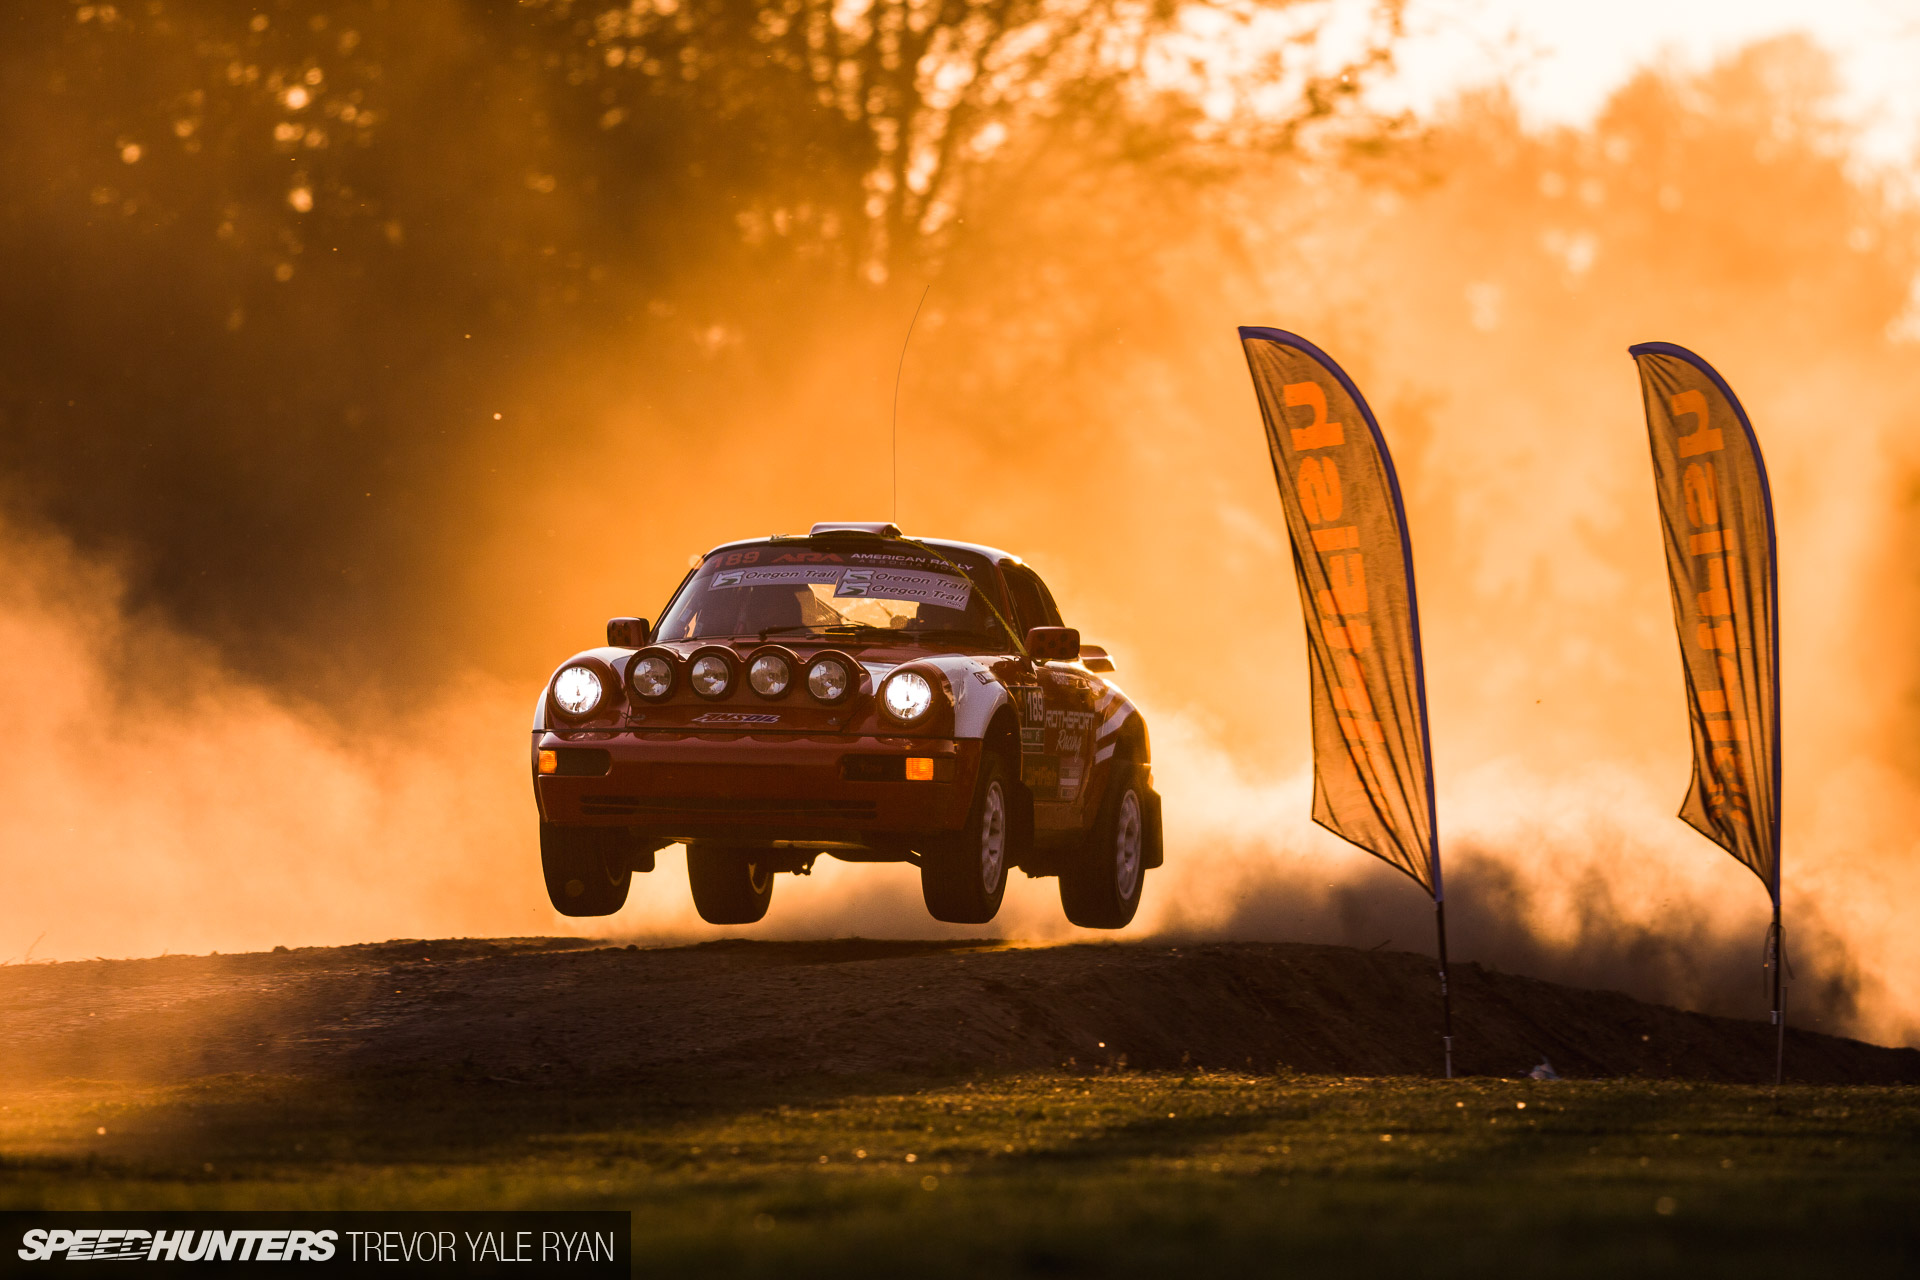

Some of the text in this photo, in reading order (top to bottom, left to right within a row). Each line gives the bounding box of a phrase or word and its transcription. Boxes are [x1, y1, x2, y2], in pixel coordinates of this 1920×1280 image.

[711, 551, 845, 568] 189 ARA
[850, 553, 926, 563] AMERICAN
[745, 570, 838, 580] Oregon Trail
[875, 573, 969, 592] Oregon Trail
[871, 585, 965, 603] Oregon Trail
[1027, 691, 1043, 721] 189
[1045, 710, 1095, 730] ROTHSPORT
[1055, 729, 1082, 762] Racing
